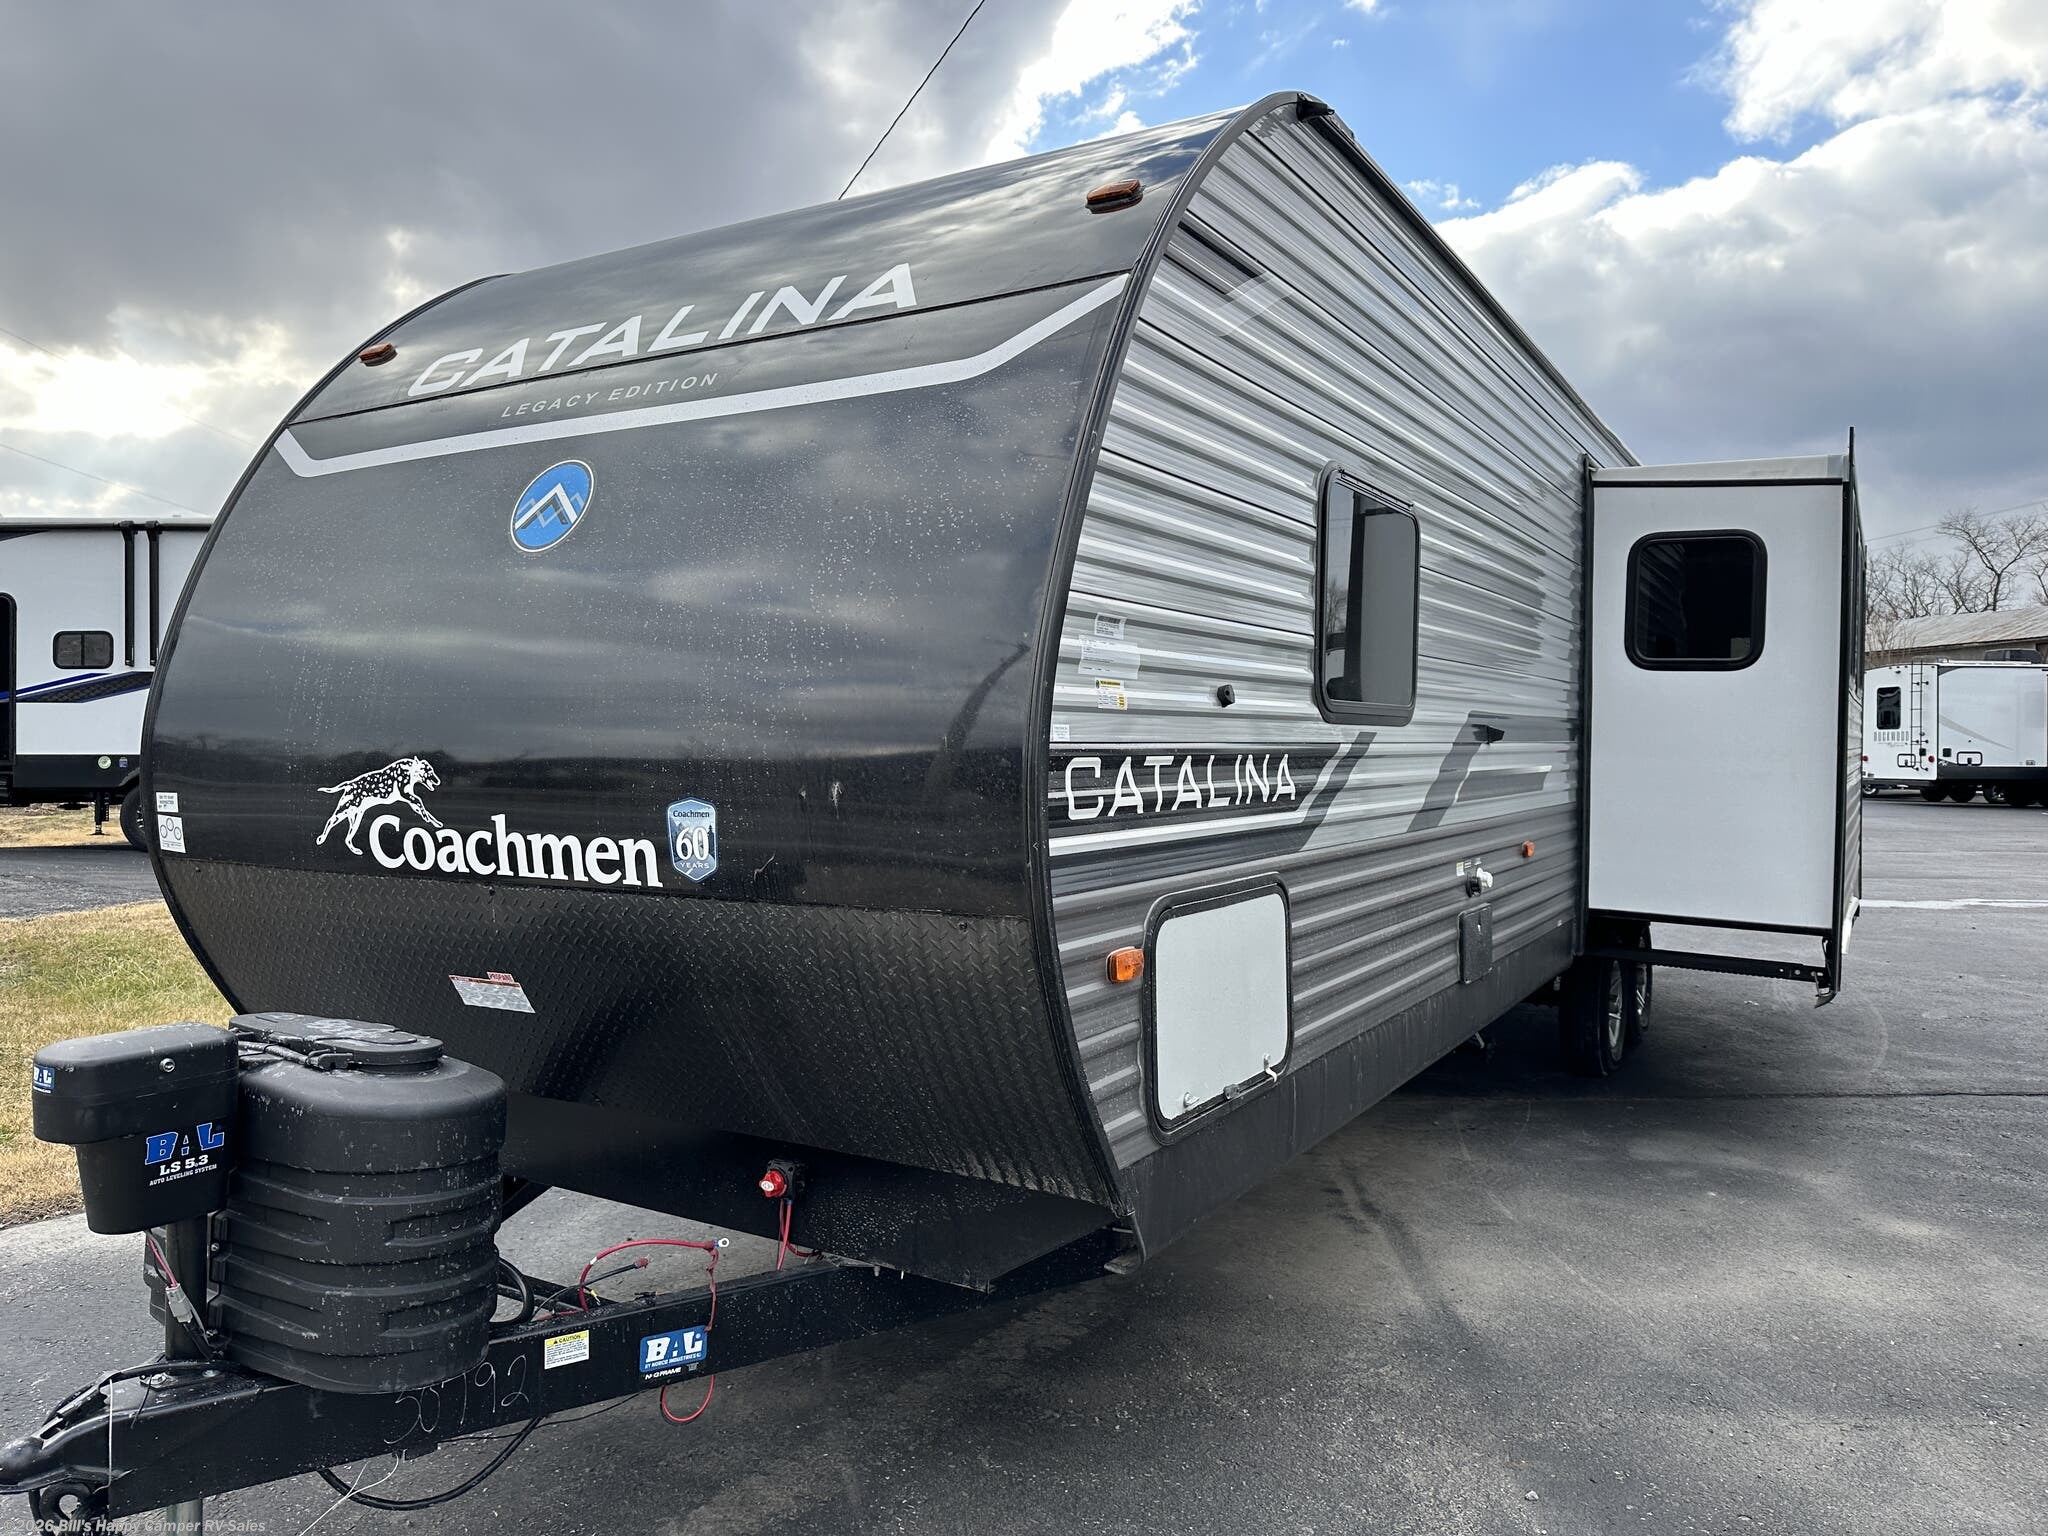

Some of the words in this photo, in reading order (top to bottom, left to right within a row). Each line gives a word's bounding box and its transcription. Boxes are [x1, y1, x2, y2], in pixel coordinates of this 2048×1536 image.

[407, 262, 918, 397] CATALINA
[501, 390, 598, 418] LEGACY
[608, 372, 719, 401] EDITION
[1065, 754, 1296, 821] CATALINA
[672, 810, 710, 818] Coachmen
[368, 813, 663, 888] Coachmen
[676, 827, 709, 861] 60
[149, 1178, 165, 1186] AUTO
[166, 1170, 194, 1182] LEVELING
[195, 1164, 217, 1175] SYSTEM
[160, 1161, 181, 1176] LS
[185, 1154, 209, 1169] 5.3
[559, 1334, 581, 1343] CAUTION
